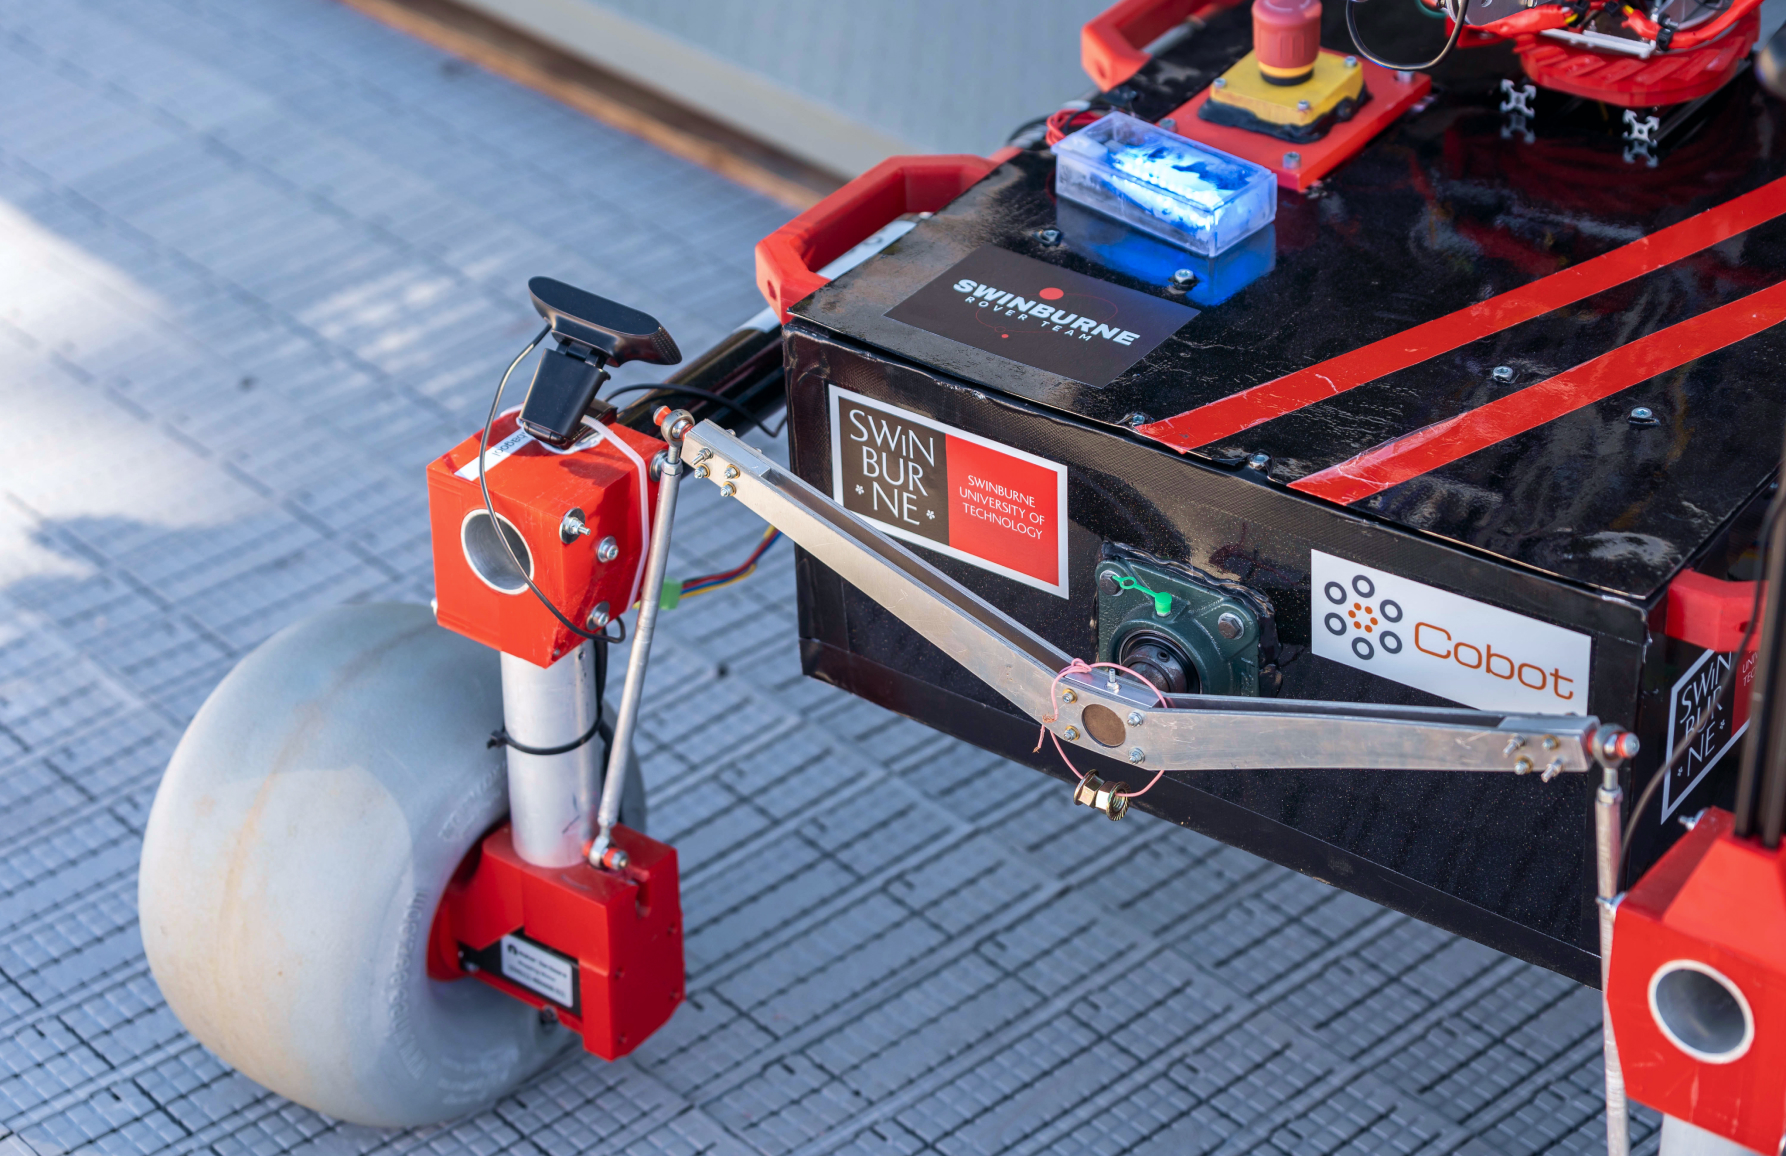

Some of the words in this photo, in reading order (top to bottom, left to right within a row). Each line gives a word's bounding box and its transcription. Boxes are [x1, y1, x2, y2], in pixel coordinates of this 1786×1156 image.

[953, 279, 1141, 346] SWINBURNE
[965, 296, 1029, 321] ROVER
[1041, 320, 1093, 342] TEAM
[862, 445, 929, 497] BUR
[967, 474, 1036, 508] SWINBURNE
[872, 481, 921, 526] NE
[958, 486, 1026, 519] UNIVERSITY
[1028, 510, 1046, 526] OF
[962, 501, 1044, 540] TECHNOLOGY
[1414, 621, 1575, 701] Cobot
[1686, 721, 1716, 777] NE
